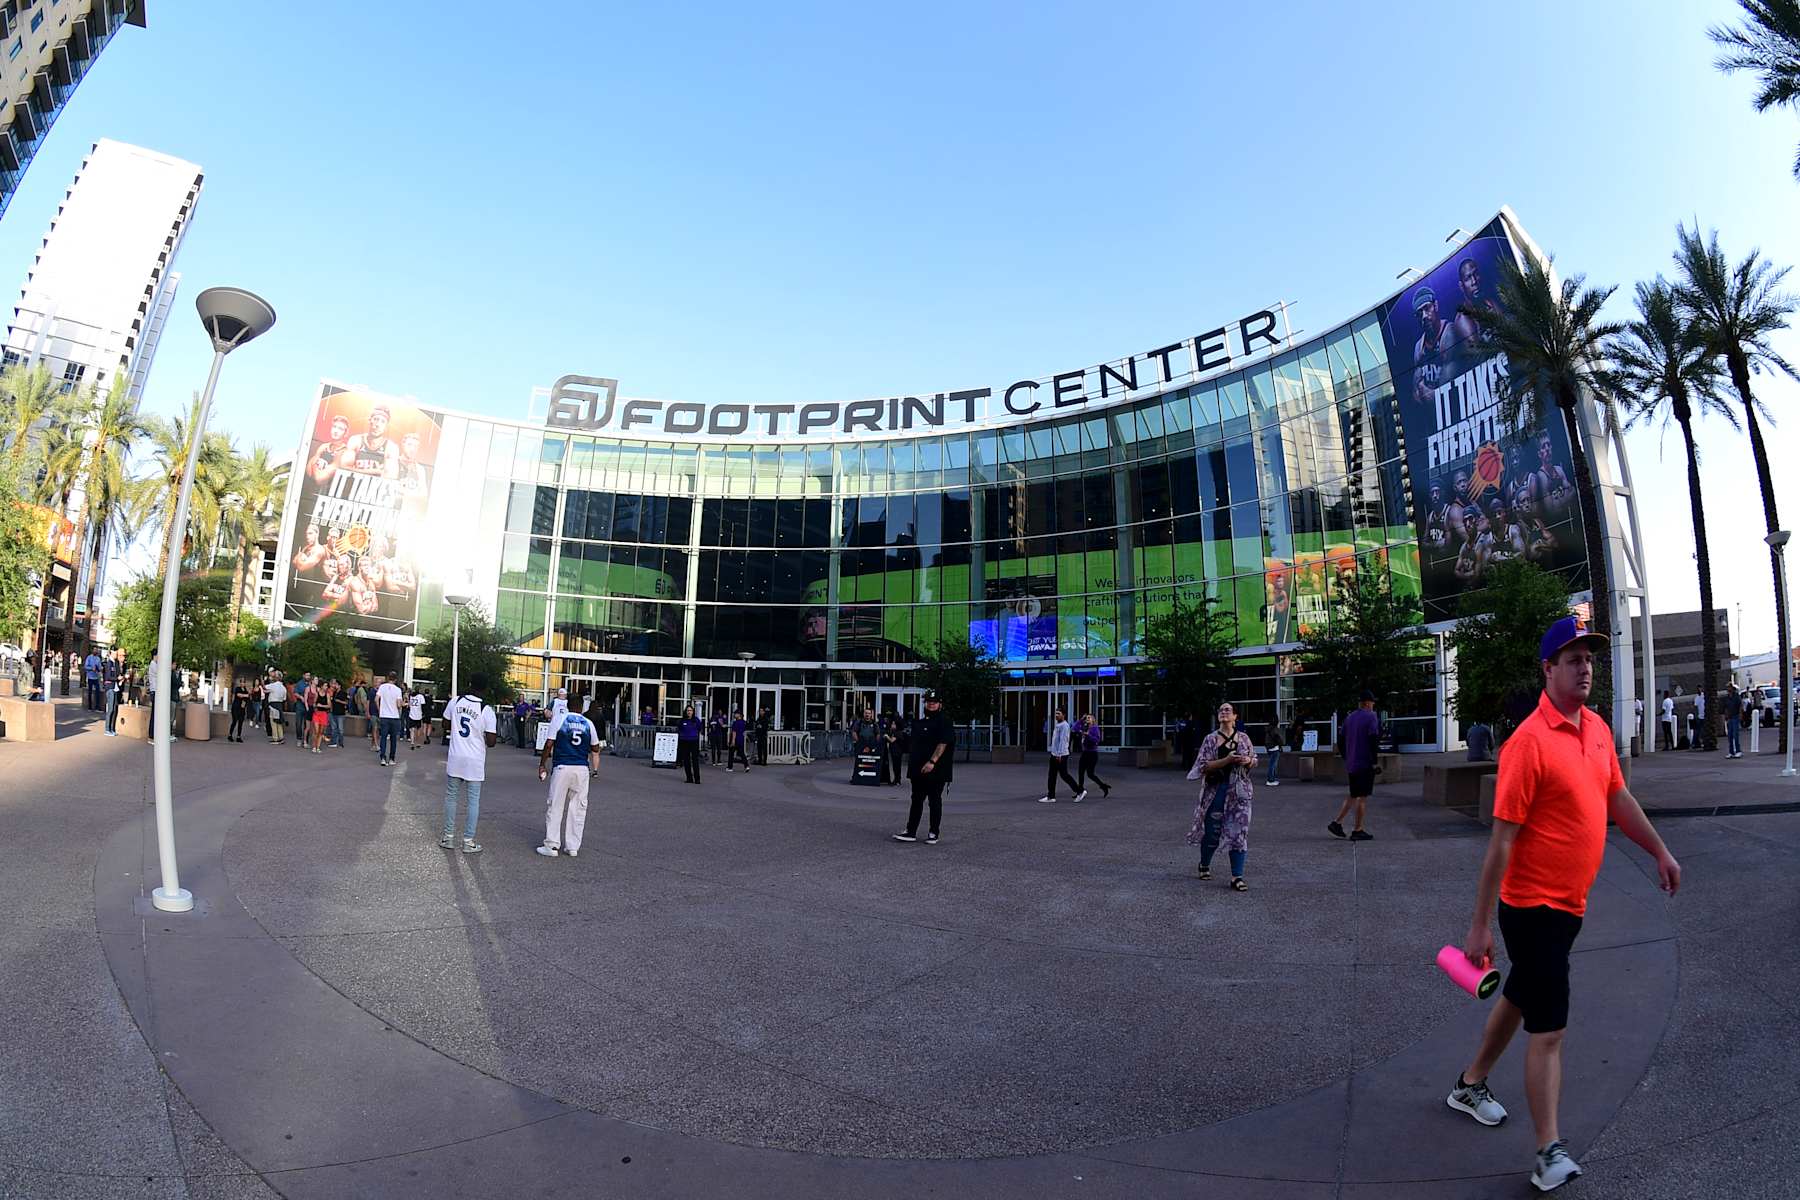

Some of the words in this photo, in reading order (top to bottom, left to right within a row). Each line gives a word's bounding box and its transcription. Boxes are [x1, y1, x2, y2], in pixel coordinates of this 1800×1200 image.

[620, 386, 991, 435] FOOTPRINT
[1004, 310, 1281, 415] CENTER
[1434, 381, 1452, 431] IT
[327, 469, 351, 501] IT
[1094, 578, 1112, 588] We
[1085, 593, 1120, 607] craftin
[458, 716, 471, 738] 5
[571, 730, 582, 745] 5
